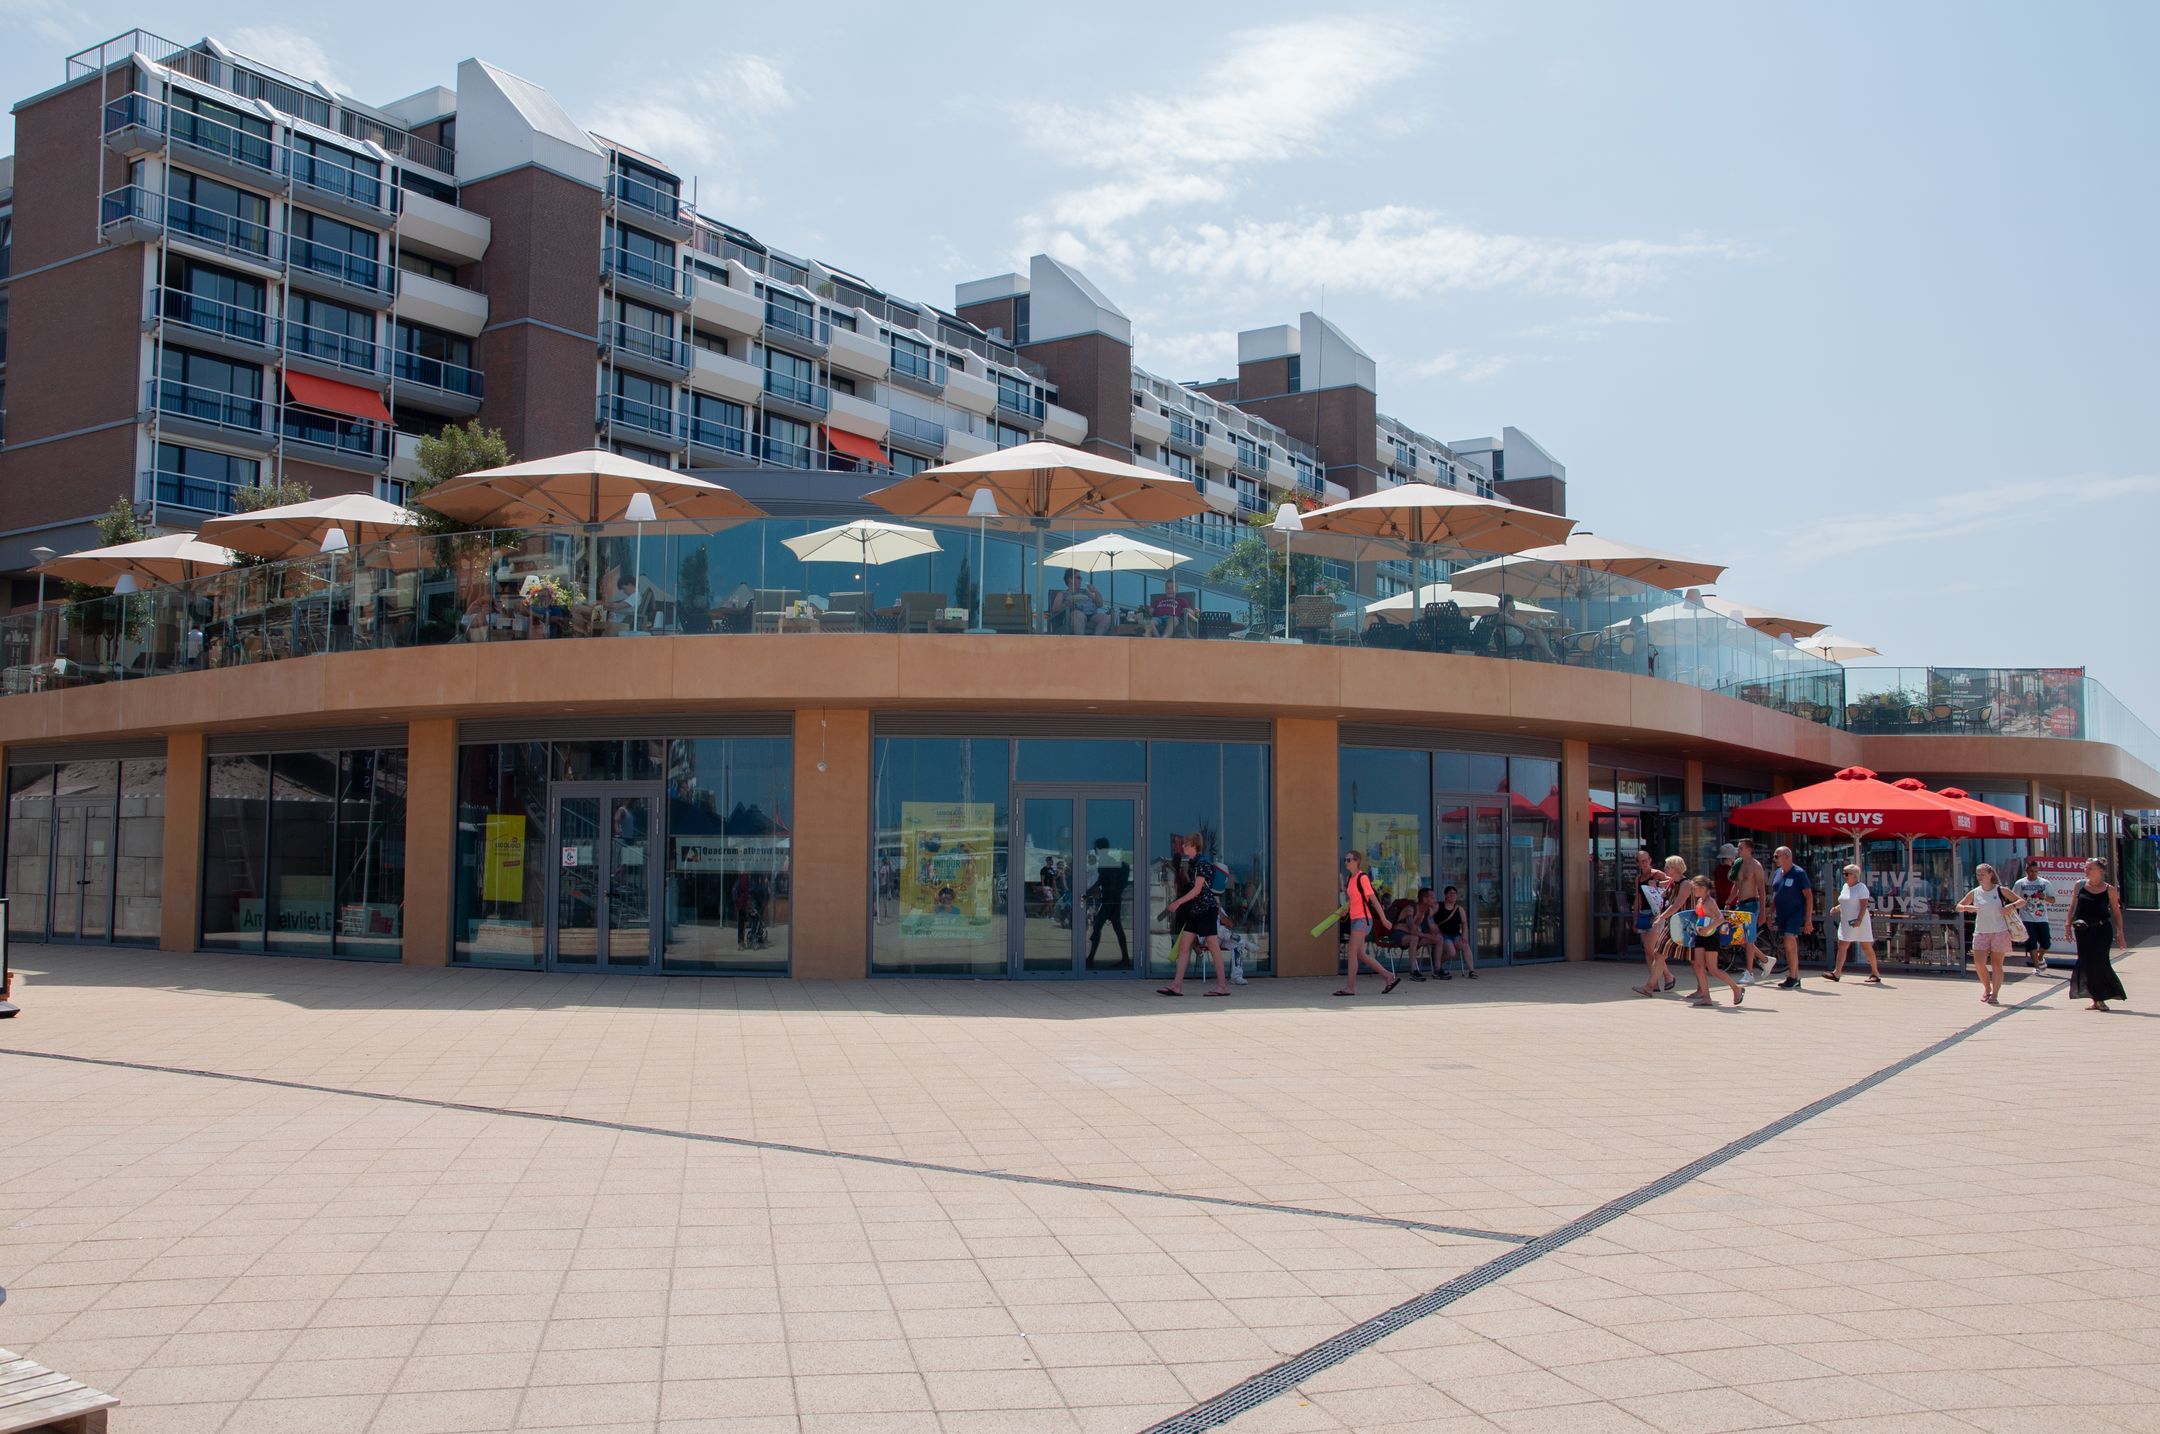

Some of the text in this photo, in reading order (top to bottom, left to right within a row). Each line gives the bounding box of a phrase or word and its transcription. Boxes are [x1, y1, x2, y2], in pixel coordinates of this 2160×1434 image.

[1791, 811, 1884, 825] FIVE GUYS
[2057, 861, 2085, 869] GUYS
[1866, 871, 1922, 888] FIVE
